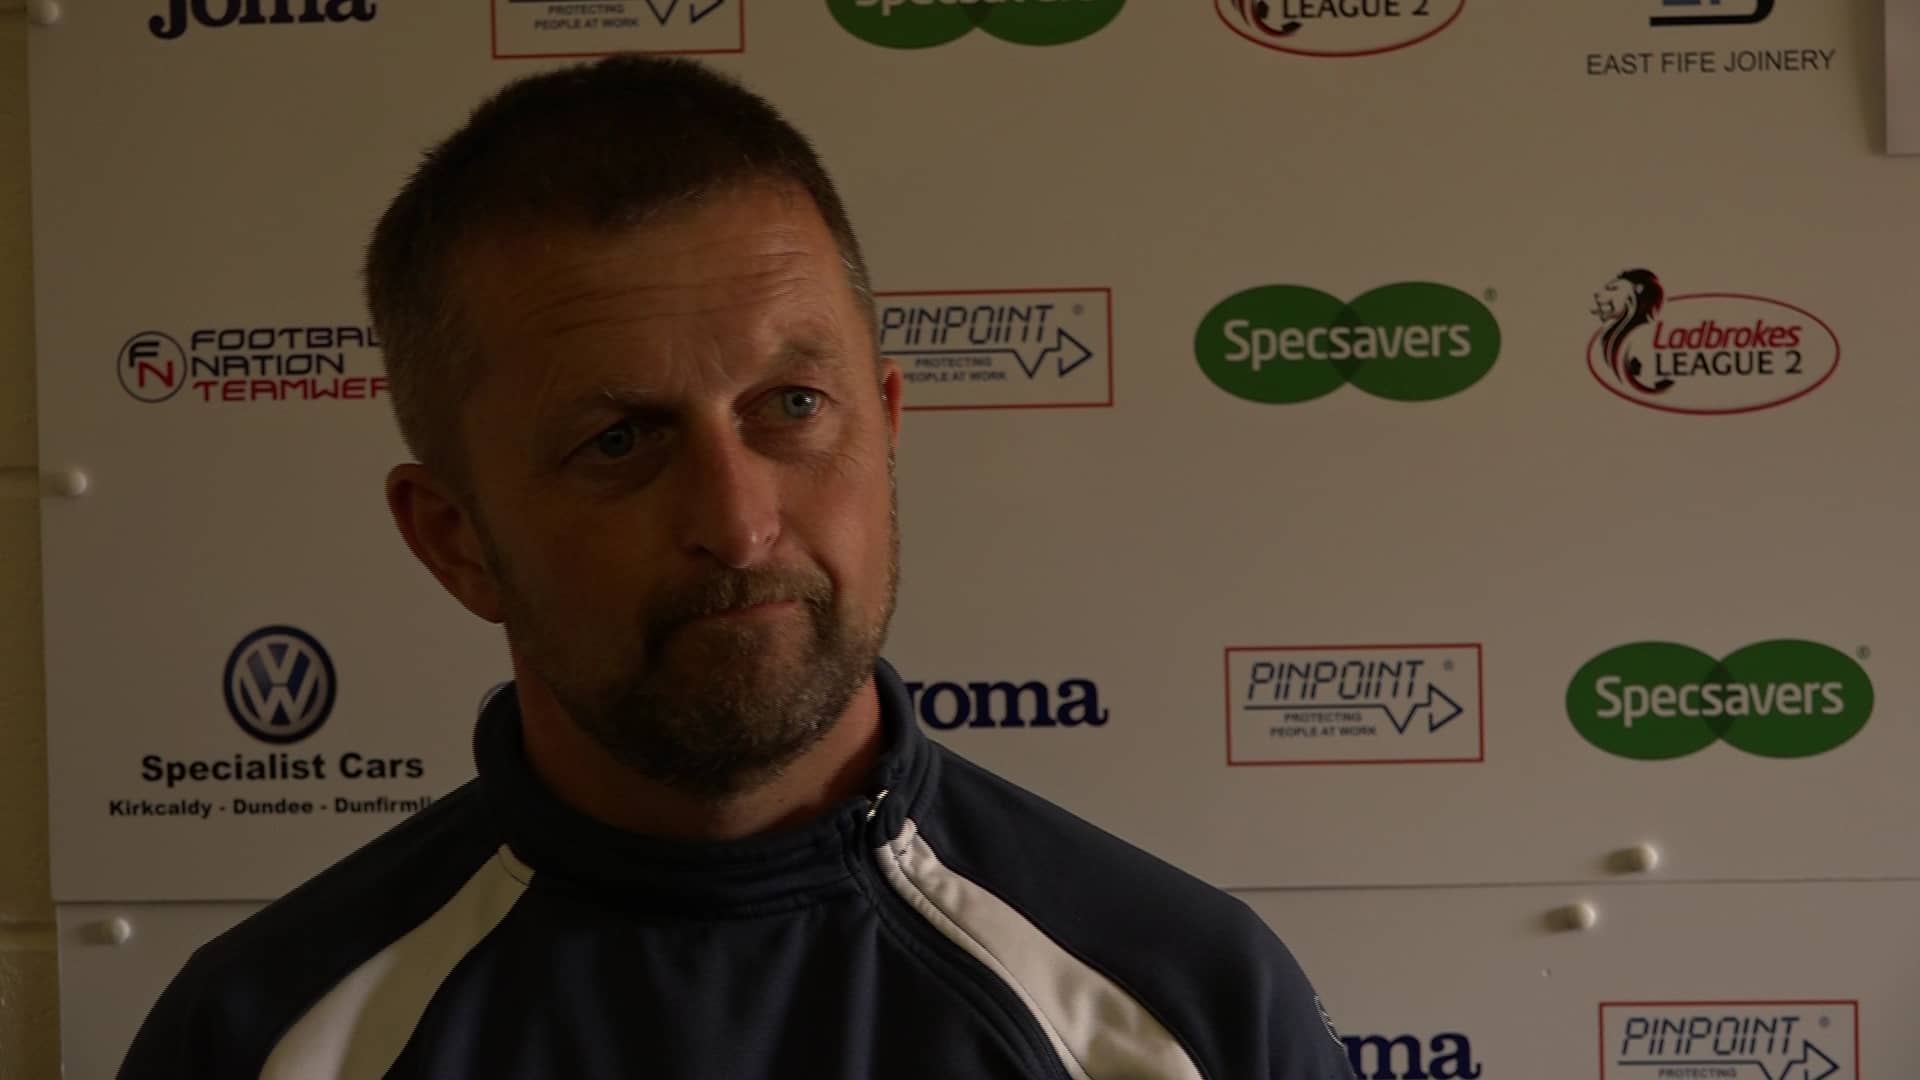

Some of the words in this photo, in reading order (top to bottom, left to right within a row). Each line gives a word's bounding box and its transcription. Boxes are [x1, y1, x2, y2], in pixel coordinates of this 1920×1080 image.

[1283, 0, 1400, 18] LEAGUE
[1587, 53, 1653, 75] EAST
[1661, 51, 1716, 73] FIFE
[1723, 49, 1836, 72] JOINERY
[880, 304, 1054, 345] PINPOINT
[1652, 319, 1803, 350] Ladbrokes
[191, 326, 383, 351] FOOTBAL
[1223, 318, 1472, 373] Specsavers
[192, 353, 344, 377] NATION
[1655, 350, 1774, 376] LEAGUE
[1784, 349, 1803, 374] 2
[1247, 659, 1425, 701] PINPOINT
[1594, 674, 1845, 730] Specsavers
[1284, 711, 1363, 723] PROTECTING
[1269, 726, 1318, 738] PEOPLE
[1320, 725, 1336, 737] AT
[1338, 725, 1377, 737] WORK
[141, 753, 326, 788] Specialist
[339, 752, 425, 779] Cars
[109, 799, 213, 819] Kirkcaldy
[232, 798, 314, 815] Dundee
[1621, 1016, 1800, 1056] PINPOINT
